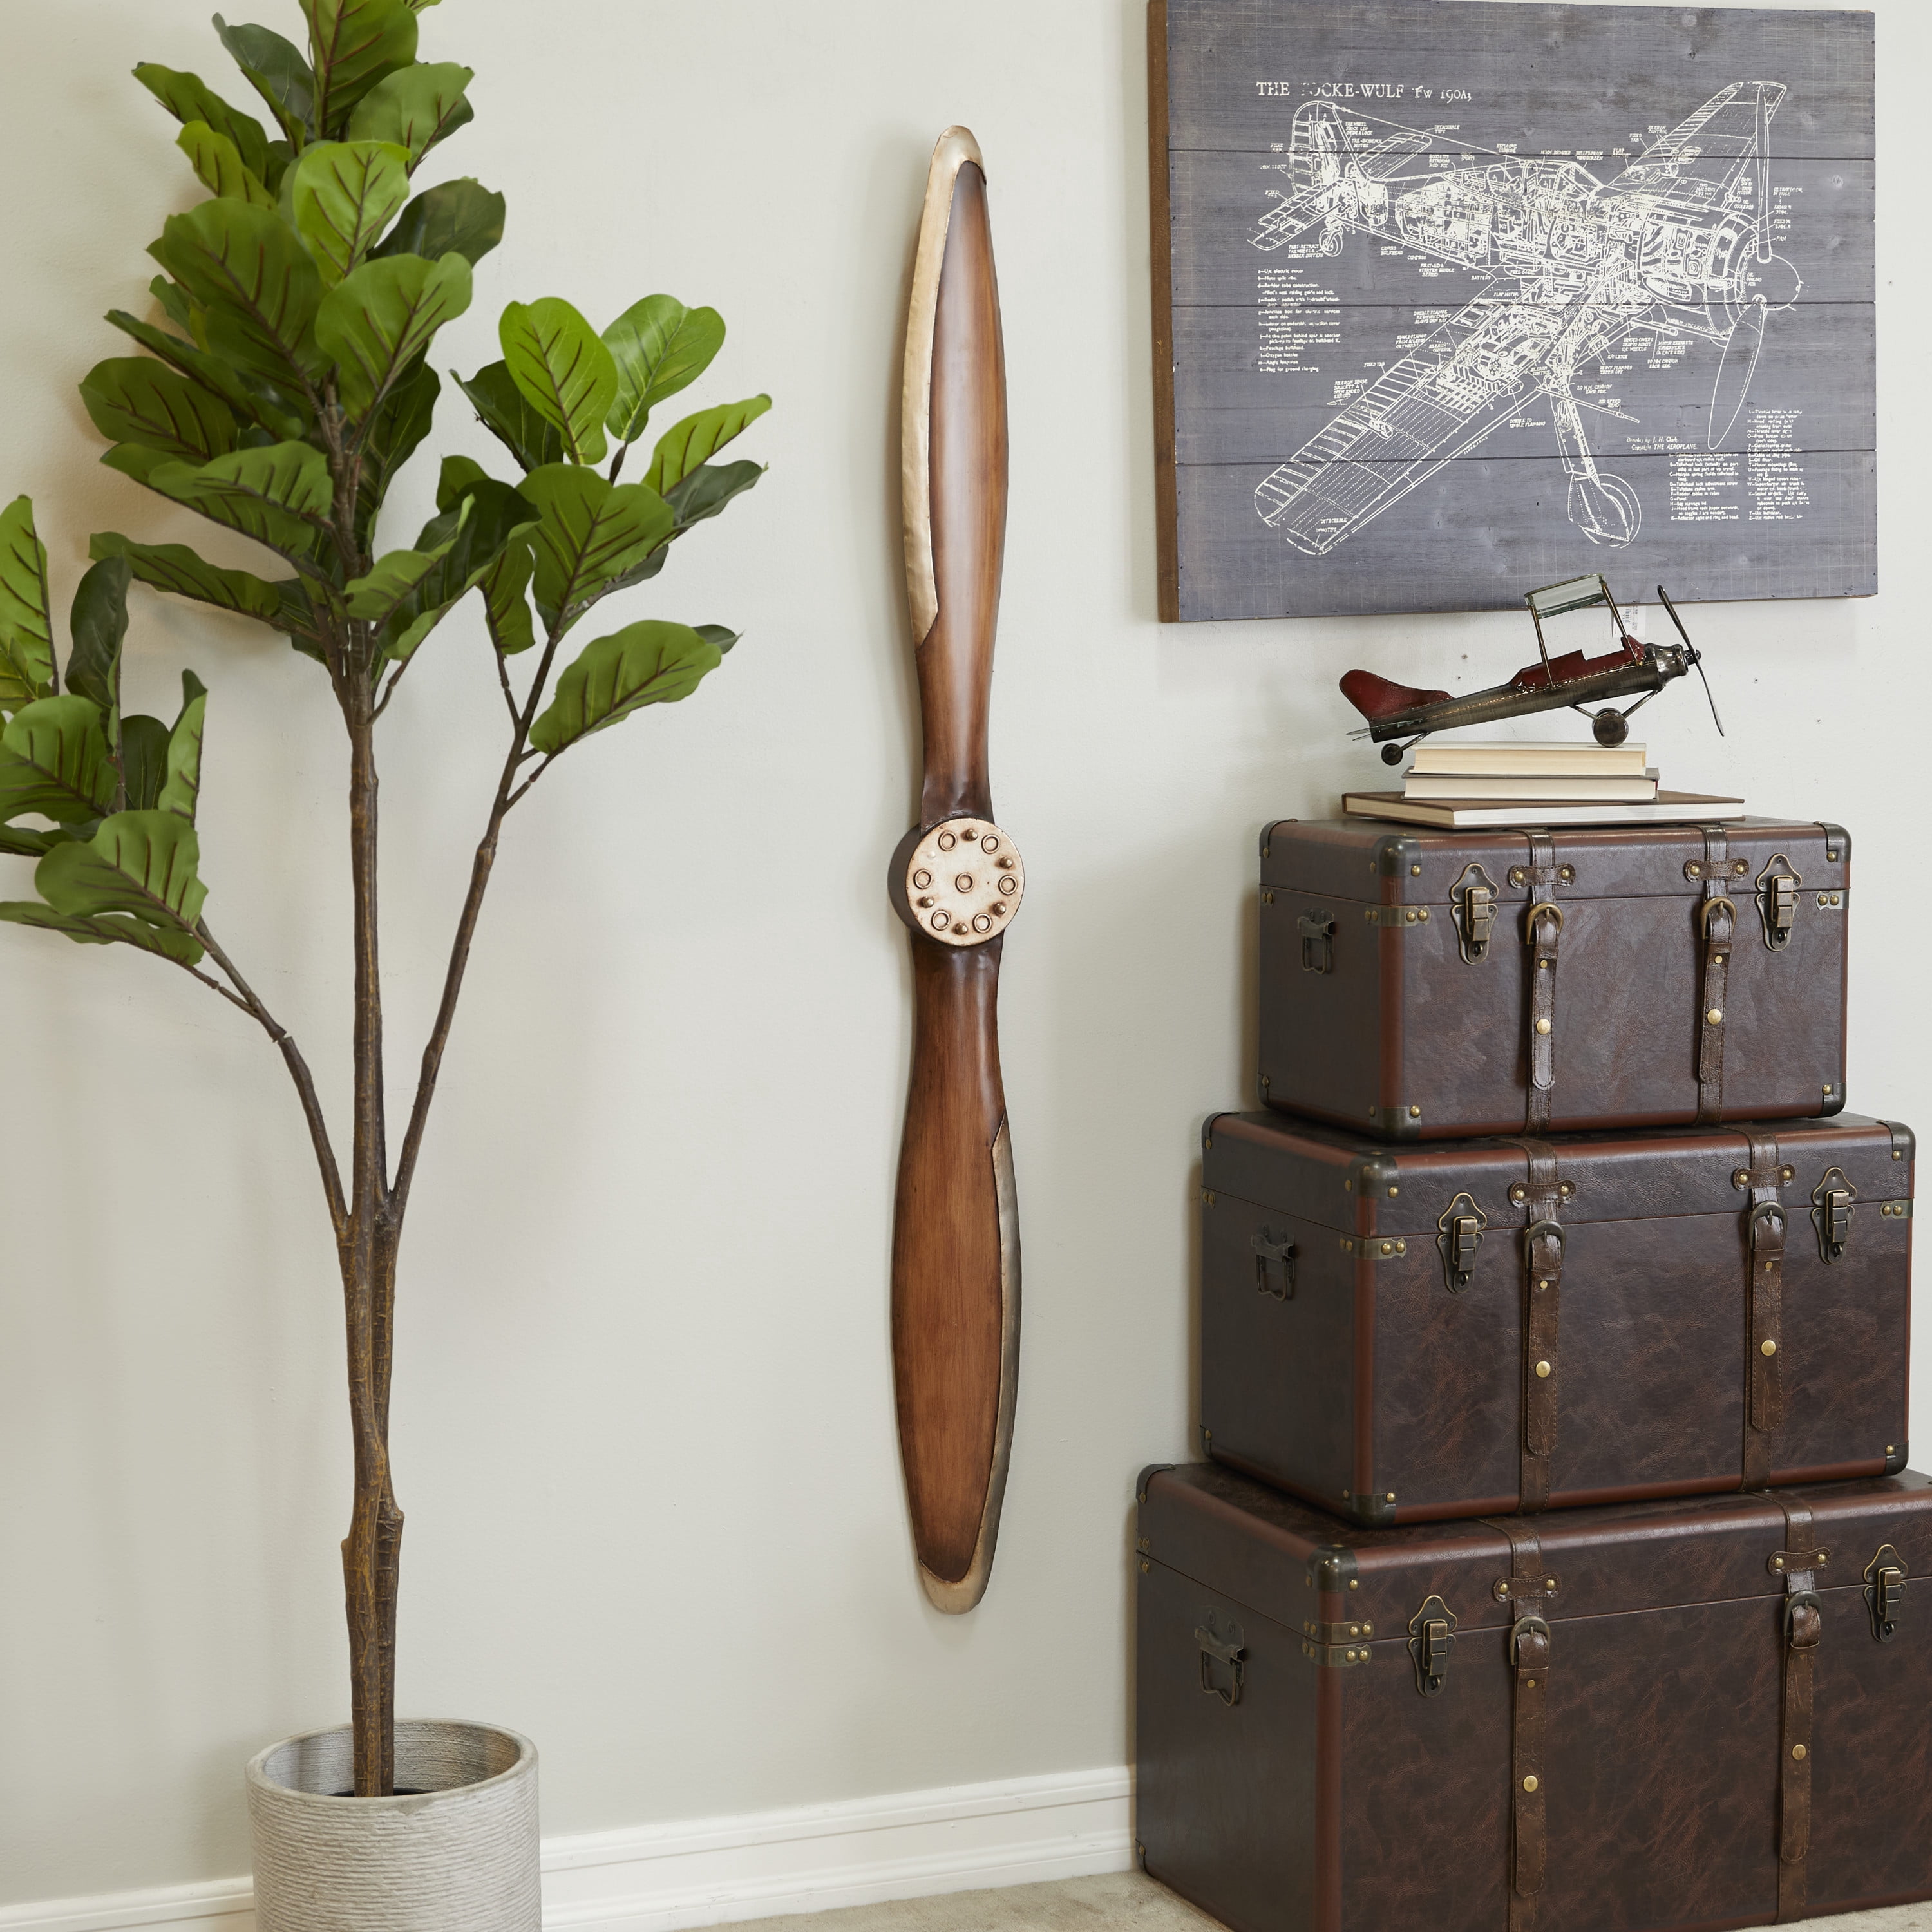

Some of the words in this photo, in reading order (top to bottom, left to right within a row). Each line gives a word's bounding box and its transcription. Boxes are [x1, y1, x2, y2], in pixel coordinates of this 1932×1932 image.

[1256, 82, 1289, 96] THE
[1411, 85, 1433, 98] Fw
[1441, 89, 1472, 103] 190A3
